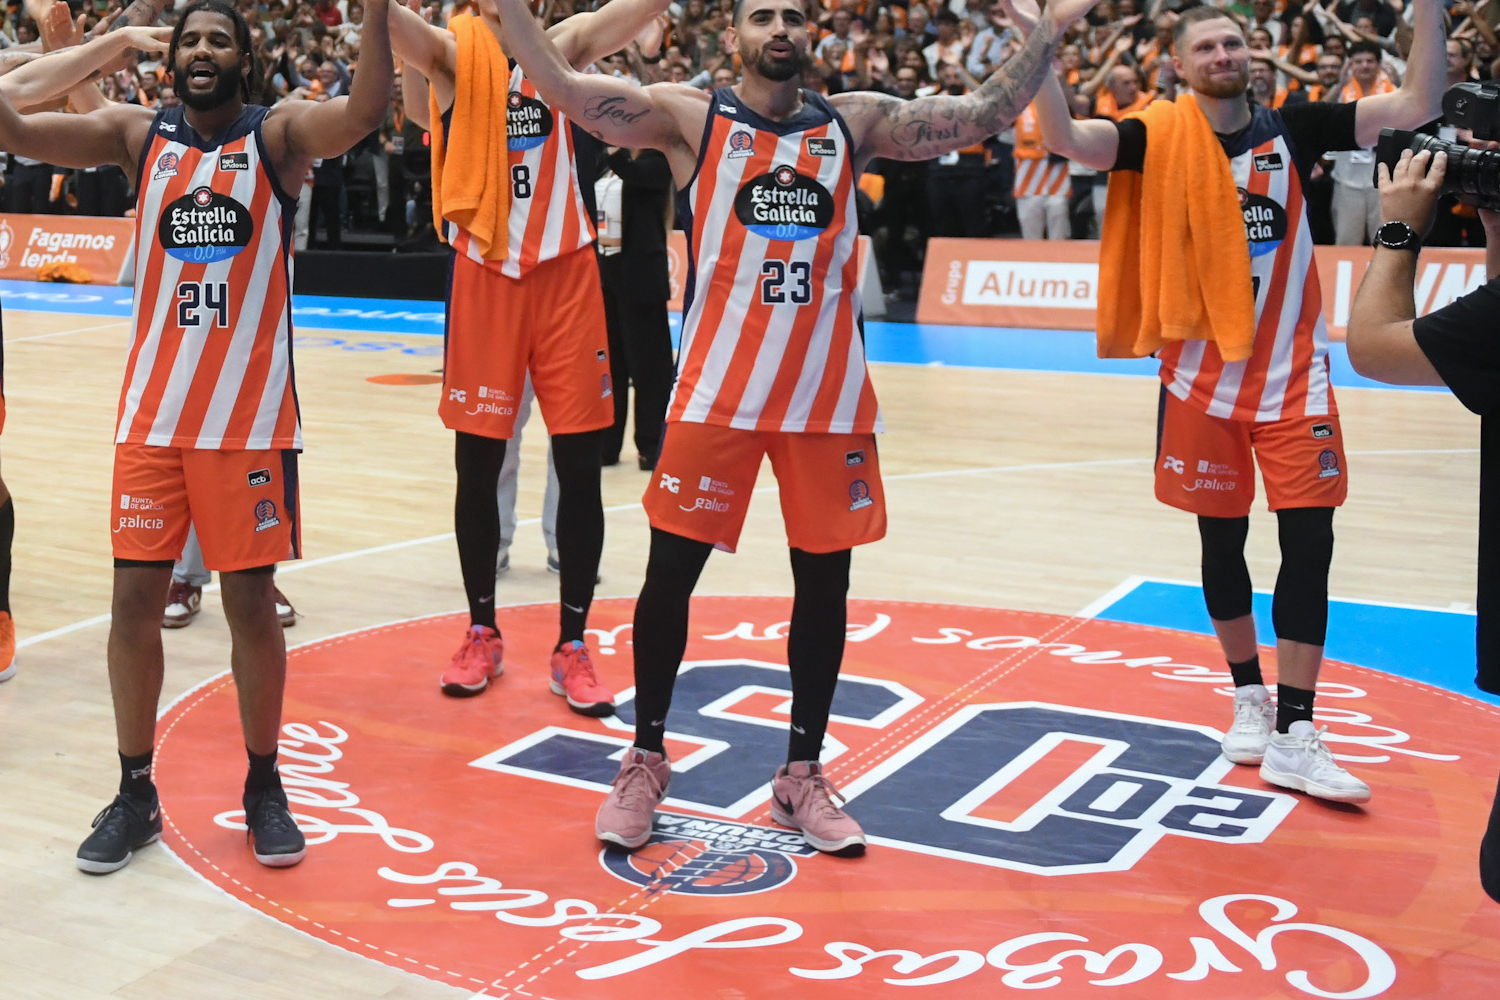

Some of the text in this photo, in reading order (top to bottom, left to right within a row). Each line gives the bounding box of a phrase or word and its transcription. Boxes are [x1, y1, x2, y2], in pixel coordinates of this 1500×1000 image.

[506, 107, 541, 121] trella
[584, 96, 650, 126] God
[506, 121, 541, 136] alicia
[892, 120, 958, 147] First
[811, 147, 836, 155] endesa
[511, 164, 532, 199] 8
[751, 185, 818, 206] Estrella
[170, 207, 237, 226] Estrella
[754, 203, 816, 223] Galicia
[1243, 206, 1274, 221] ella
[28, 228, 115, 252] Fagamos
[173, 225, 235, 245] Galicia
[1245, 223, 1273, 240] icia
[194, 244, 215, 261] 0,0
[761, 259, 812, 304] 23
[941, 260, 962, 305] Grupo
[177, 281, 229, 329] 24
[465, 402, 513, 415] galicia
[1314, 428, 1329, 437] acb
[250, 475, 266, 484] acb
[1182, 478, 1236, 492] galicia
[112, 515, 164, 533] galicia
[657, 816, 806, 845] ORUNA
[658, 826, 804, 853] BASQUET
[213, 721, 1396, 1000] Grazas Jesús Lence
